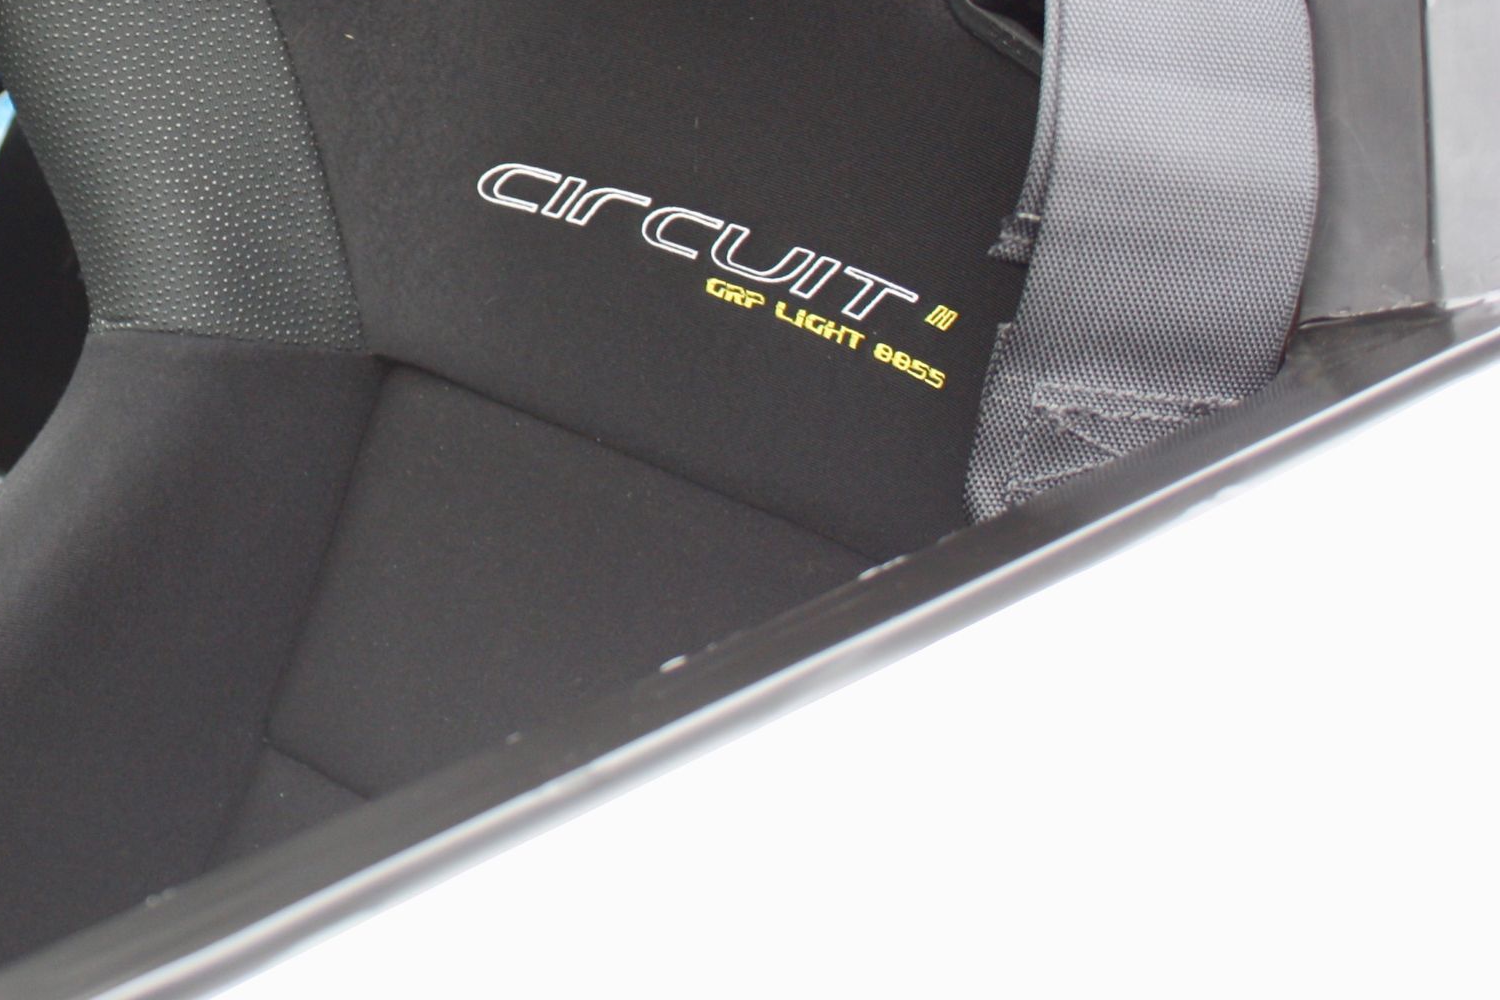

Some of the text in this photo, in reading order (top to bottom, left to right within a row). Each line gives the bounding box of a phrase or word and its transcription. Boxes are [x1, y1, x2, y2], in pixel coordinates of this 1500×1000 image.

[705, 277, 947, 390] GRP LIGHT 8855
